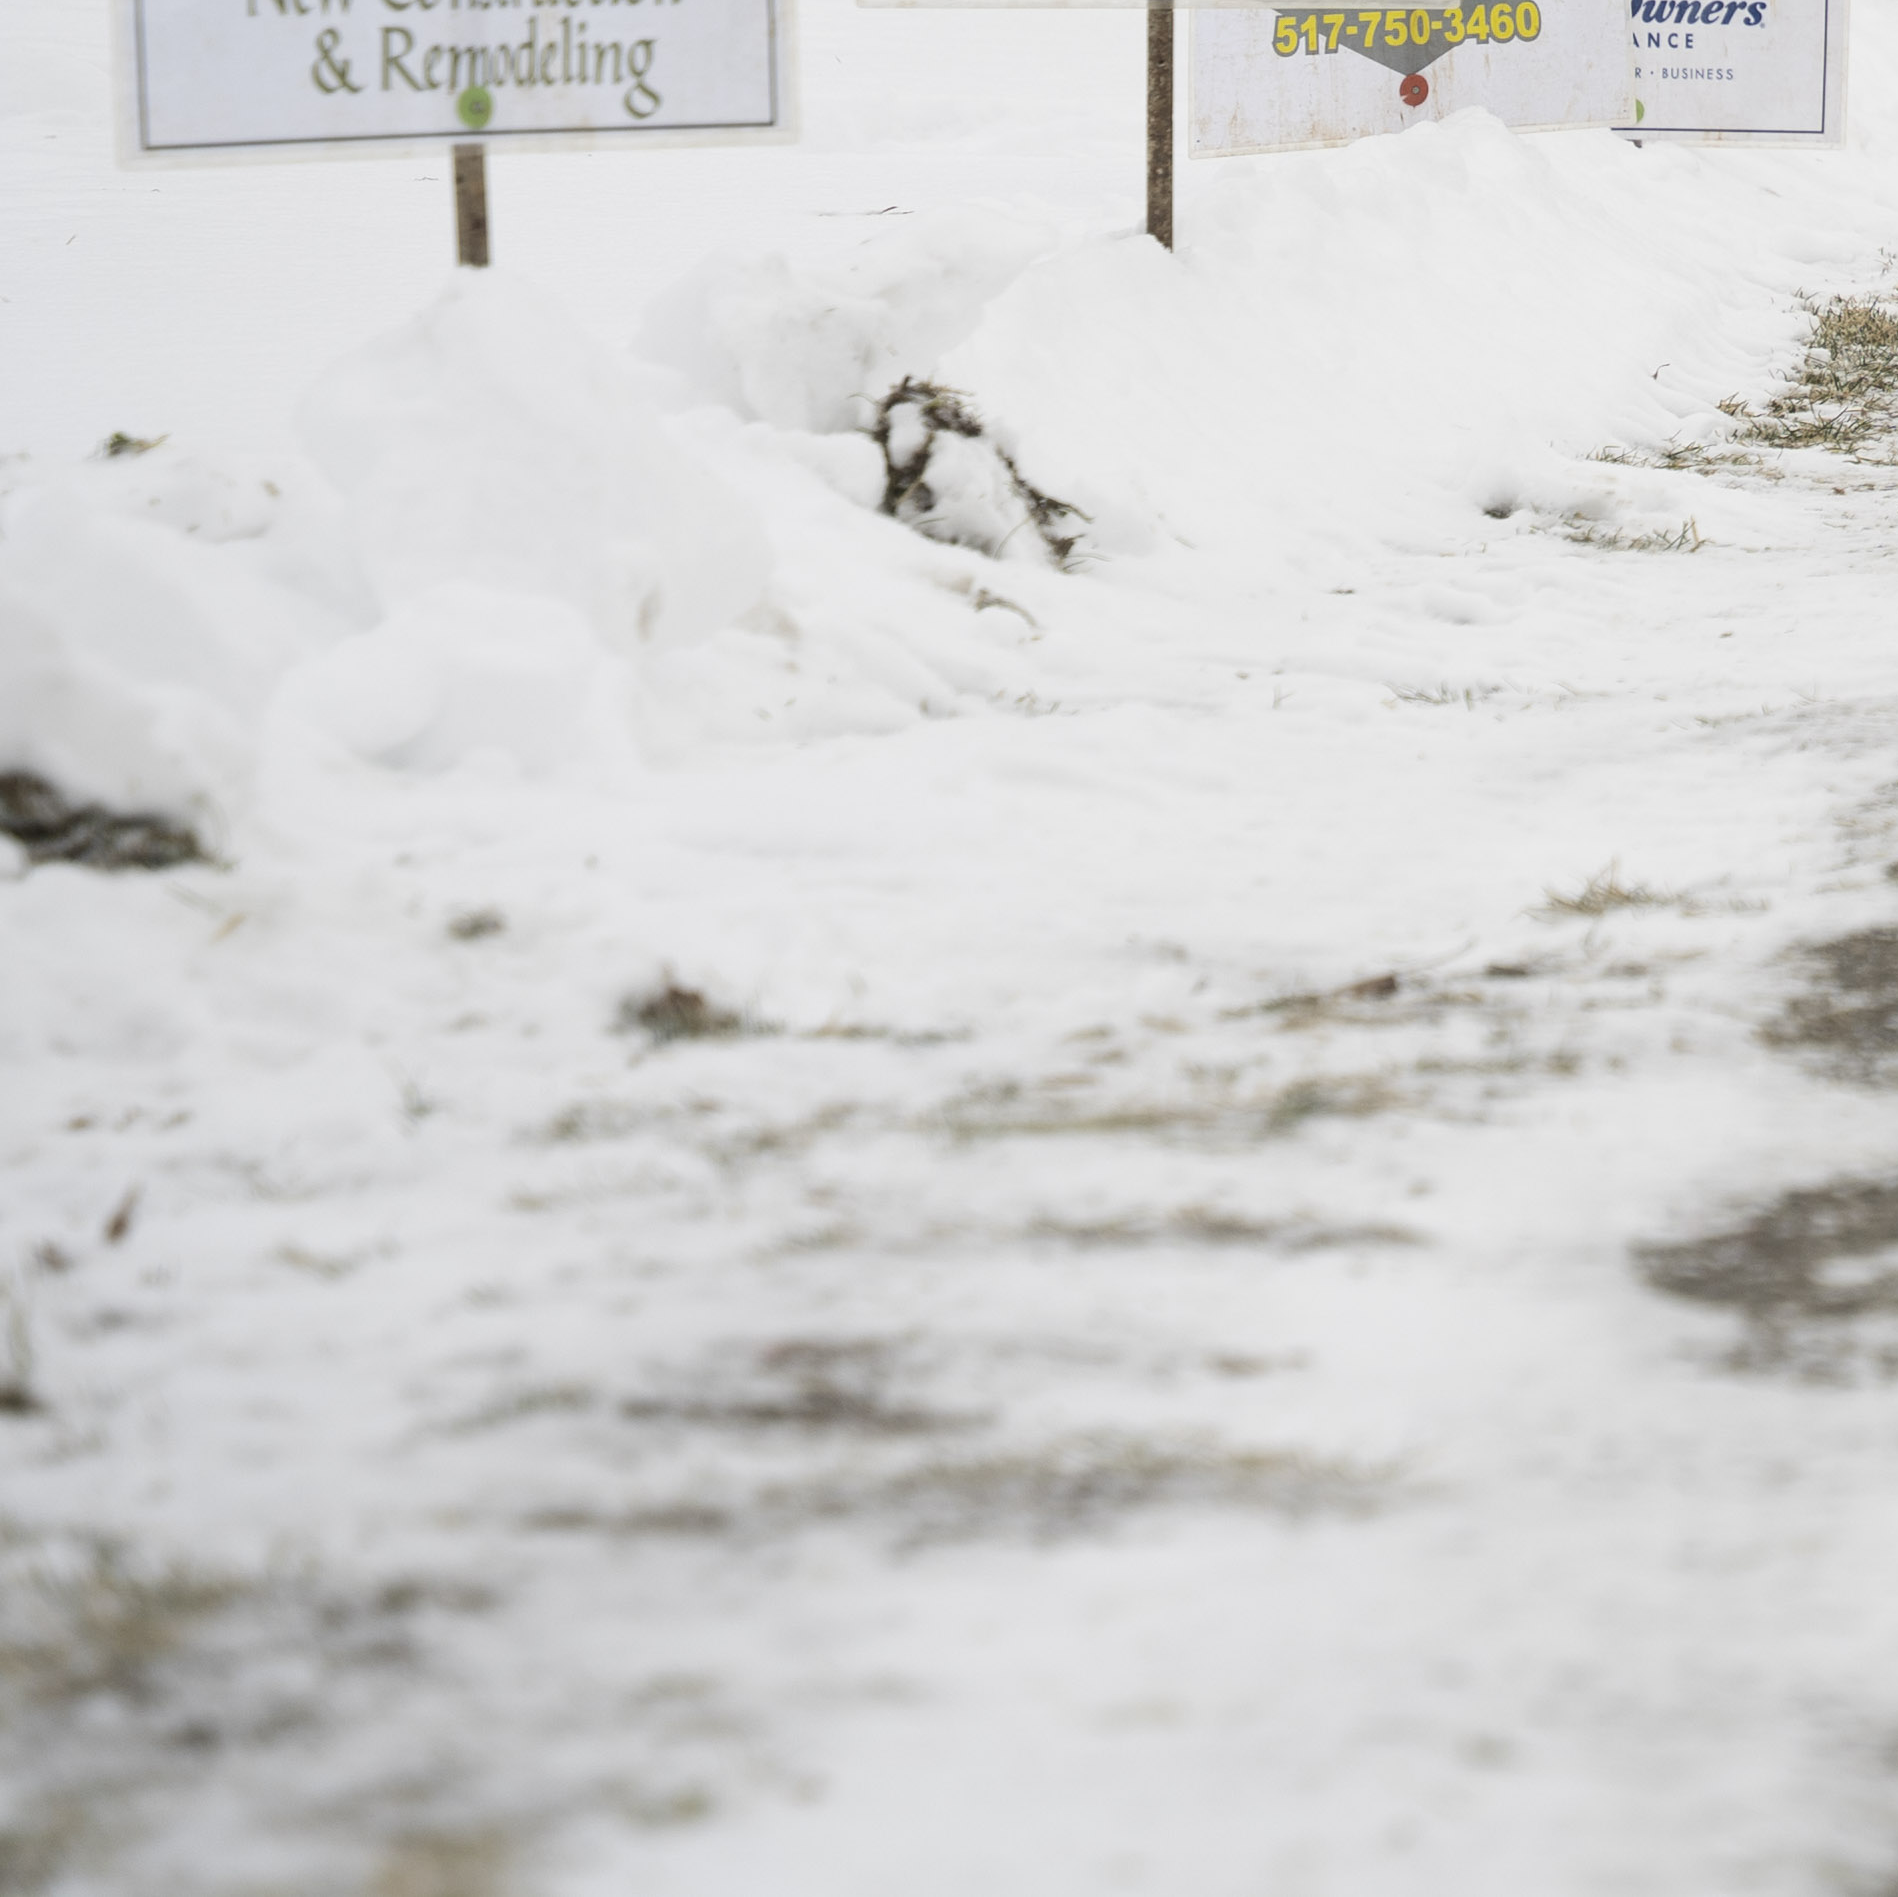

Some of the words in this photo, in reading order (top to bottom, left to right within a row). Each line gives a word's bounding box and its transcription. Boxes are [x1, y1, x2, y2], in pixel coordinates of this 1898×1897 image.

[1275, 1, 1541, 56] 517-750-3460
[312, 29, 363, 95] &
[381, 15, 661, 119] Remodeling
[1662, 68, 1734, 80] BUSINESS
